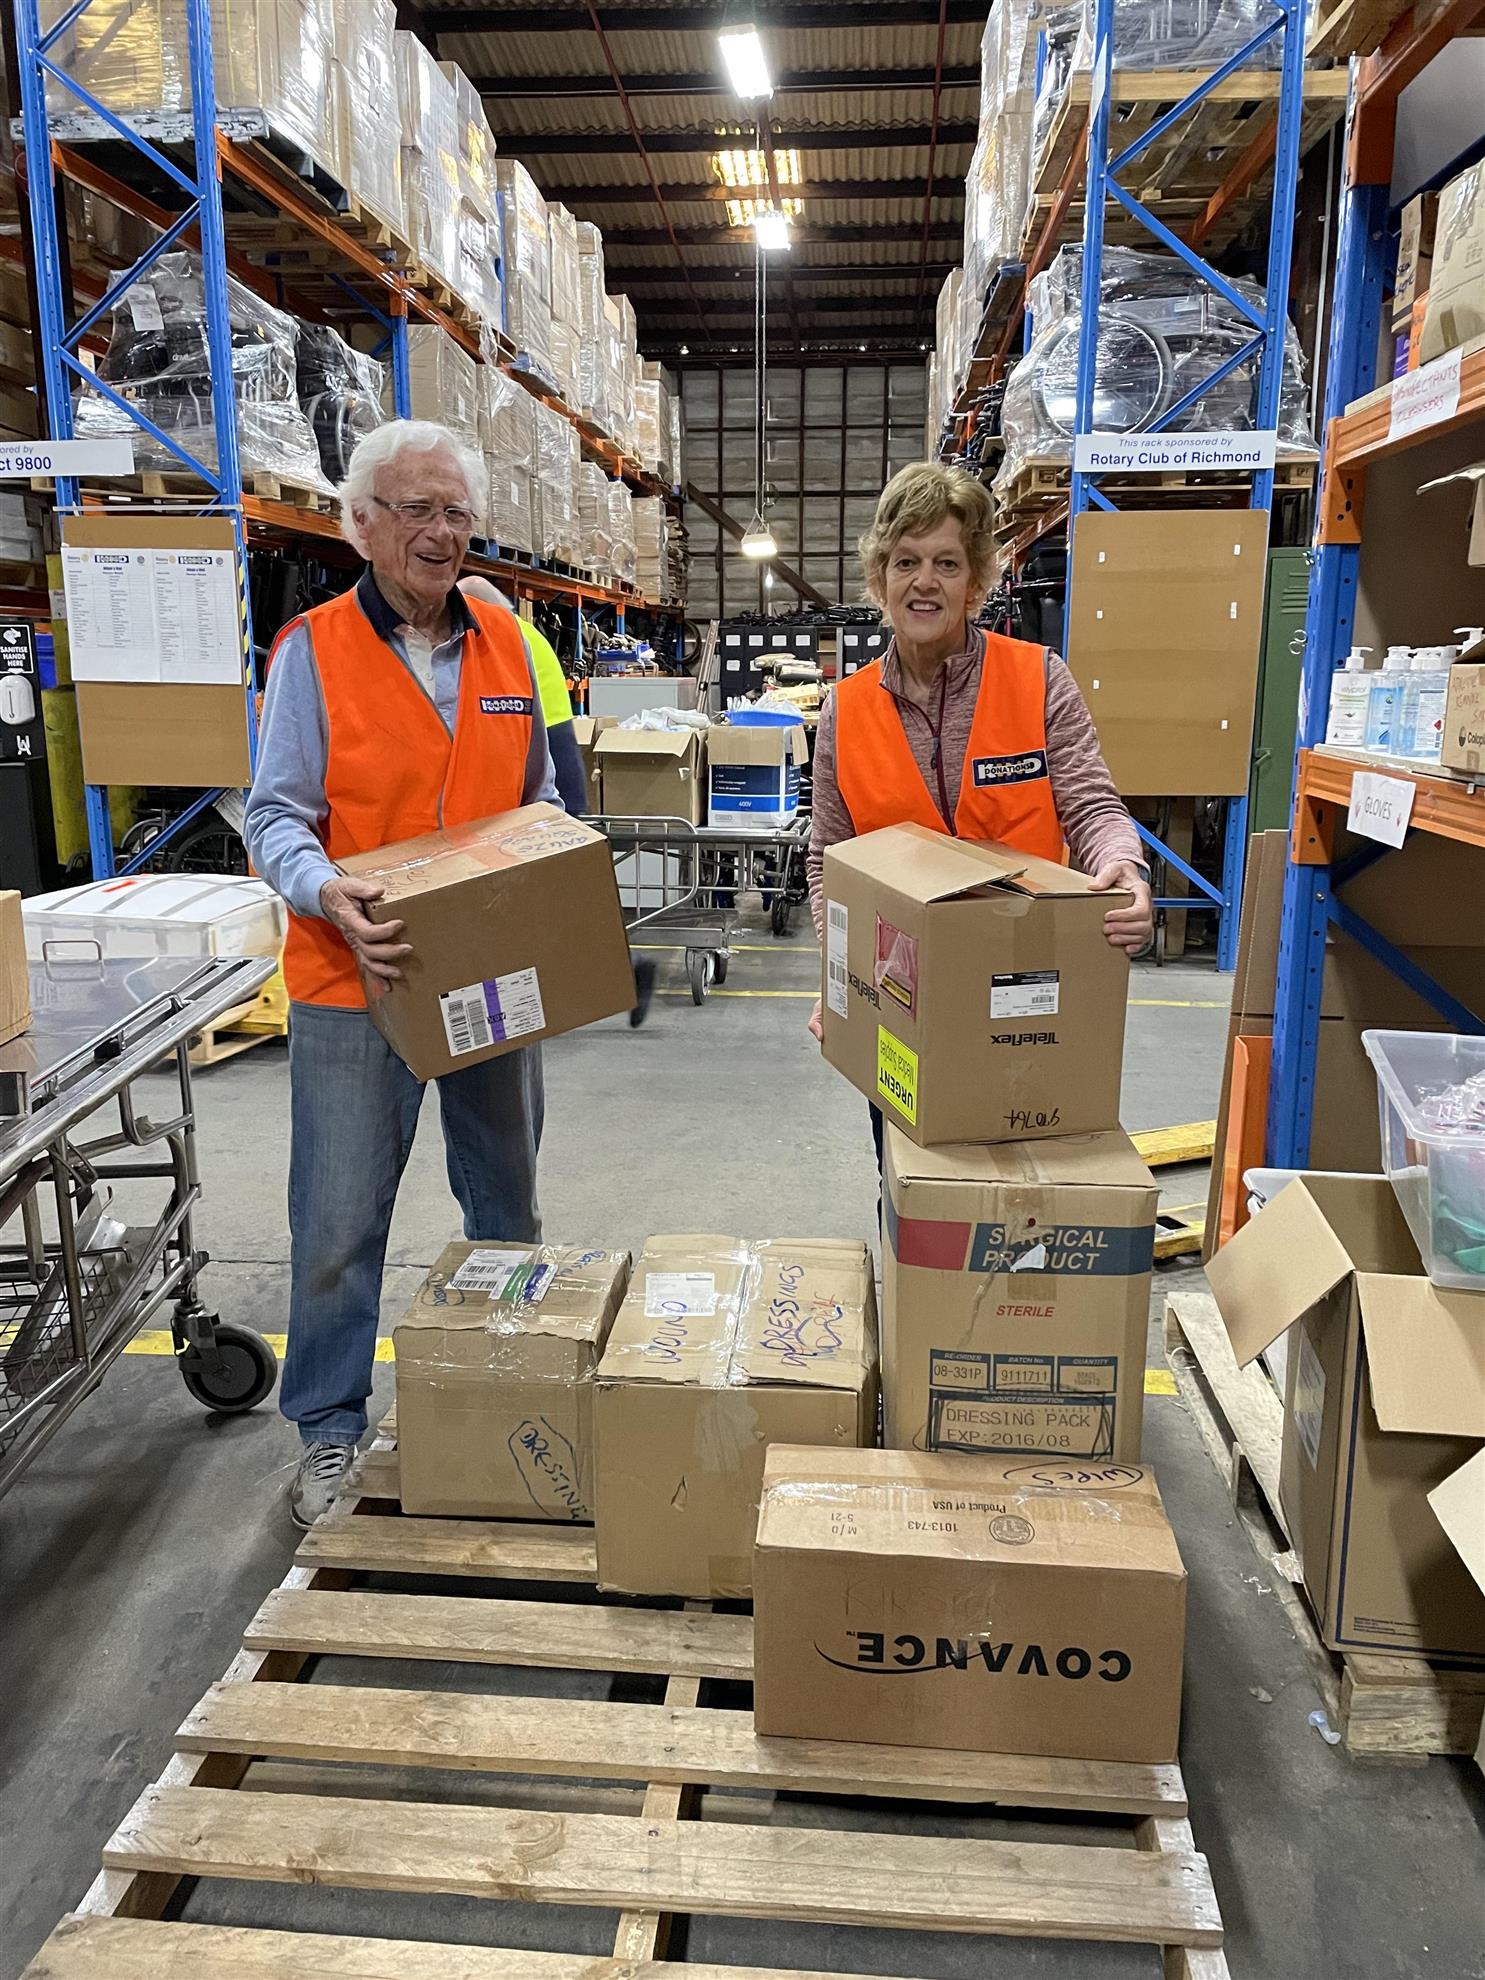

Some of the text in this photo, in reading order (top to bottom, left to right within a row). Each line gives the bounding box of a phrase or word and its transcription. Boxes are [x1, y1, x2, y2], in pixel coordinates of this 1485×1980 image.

[23, 446, 34, 455] by
[1119, 437, 1233, 449] This rack sponsored by
[15, 456, 52, 471] 9800
[1090, 450, 1261, 467] Rotary Club of Richmond
[1364, 796, 1393, 820] GLOVES
[848, 971, 882, 1011] Teleflex
[990, 1031, 1060, 1046] Teleflex
[879, 1066, 914, 1111] URGENT
[988, 1227, 1110, 1248] SGICAL
[982, 1249, 1101, 1270] PRUCT
[760, 1265, 805, 1353] DRESSINGS
[996, 1304, 1055, 1318] STERILE
[944, 1352, 982, 1361] RE-ORDER
[934, 1364, 982, 1380] 08-331P
[1001, 1369, 1048, 1383] 9111711
[1016, 1396, 1065, 1404] DESCRIPTION
[946, 1408, 1035, 1426] DRESSING
[1045, 1413, 1091, 1428] PACK
[947, 1428, 1071, 1448] EXP:2016/08
[932, 1501, 1007, 1514] Product of USA
[907, 1520, 959, 1533] 1013-743
[857, 1631, 1132, 1683] COVANCE
